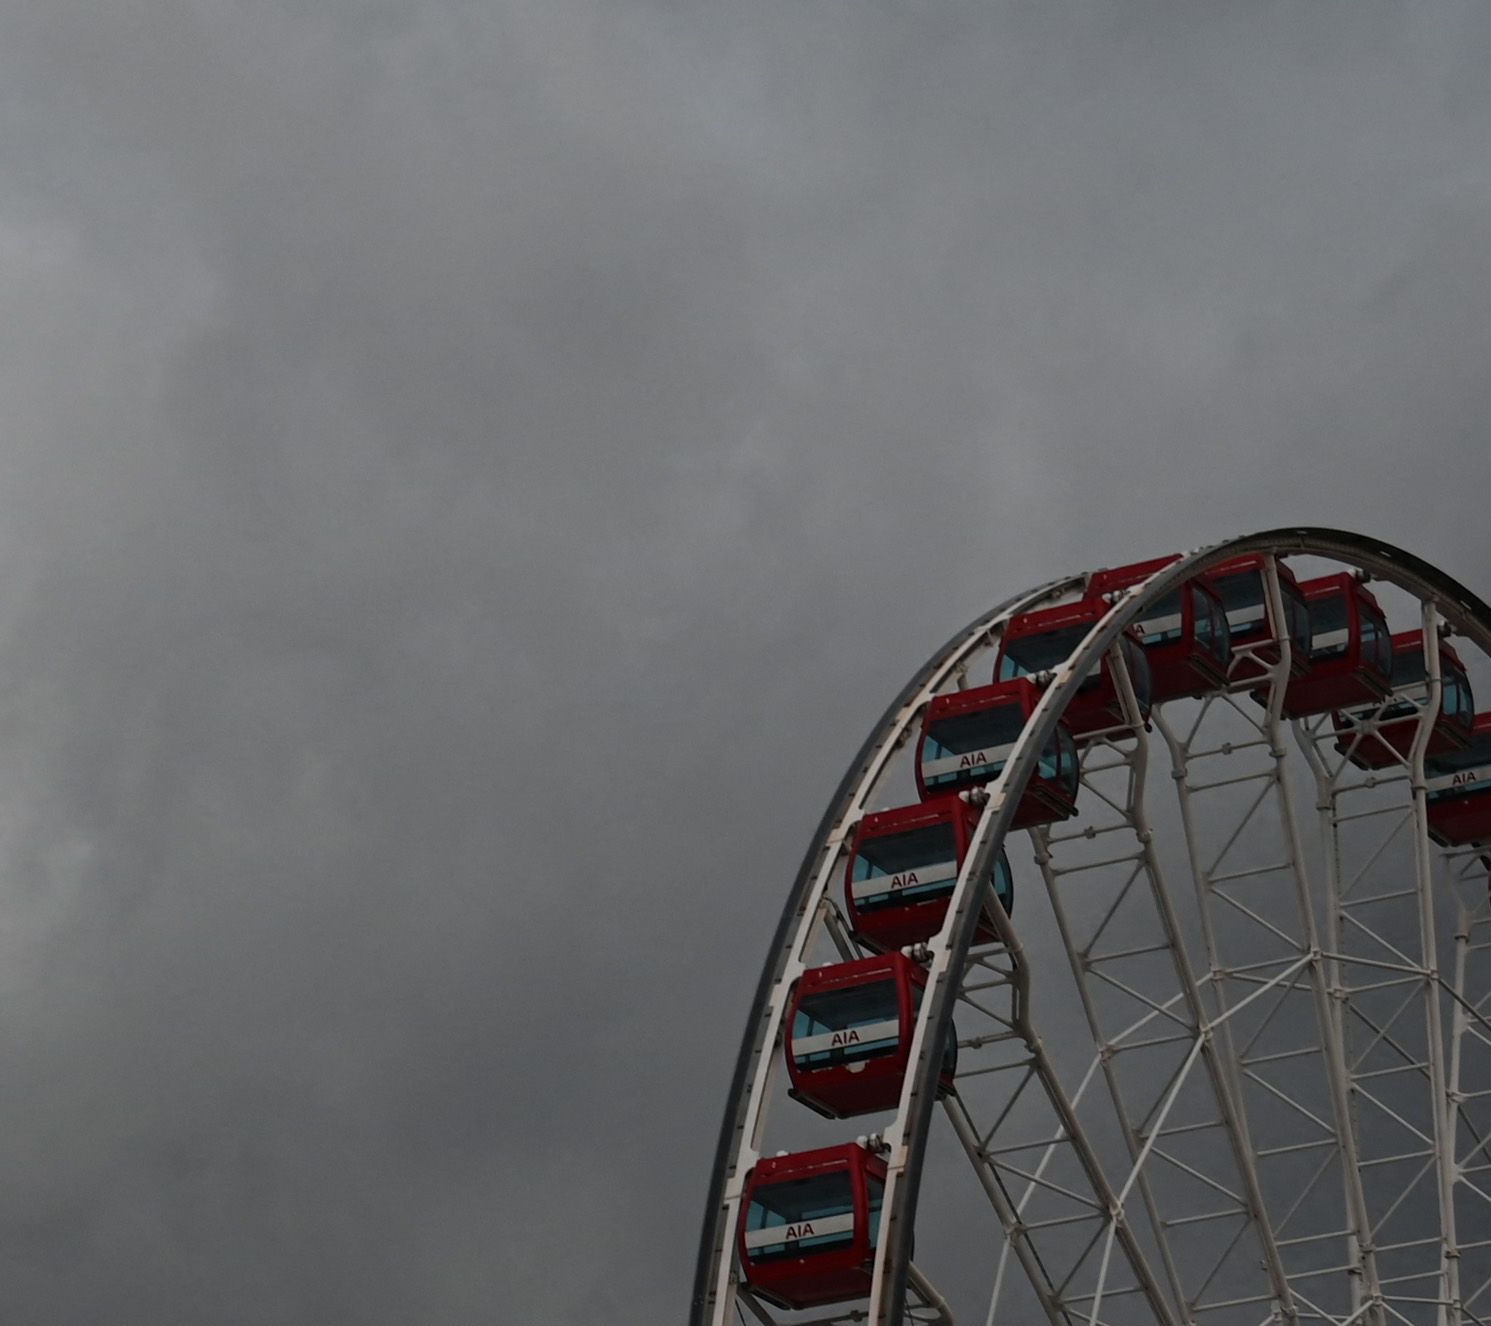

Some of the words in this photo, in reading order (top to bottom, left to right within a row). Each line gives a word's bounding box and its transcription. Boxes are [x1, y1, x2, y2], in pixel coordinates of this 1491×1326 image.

[960, 752, 987, 768] AIA
[1452, 772, 1477, 786] AIA
[891, 872, 919, 889] AIA
[832, 1030, 860, 1047] AIA
[786, 1223, 814, 1240] AIA
